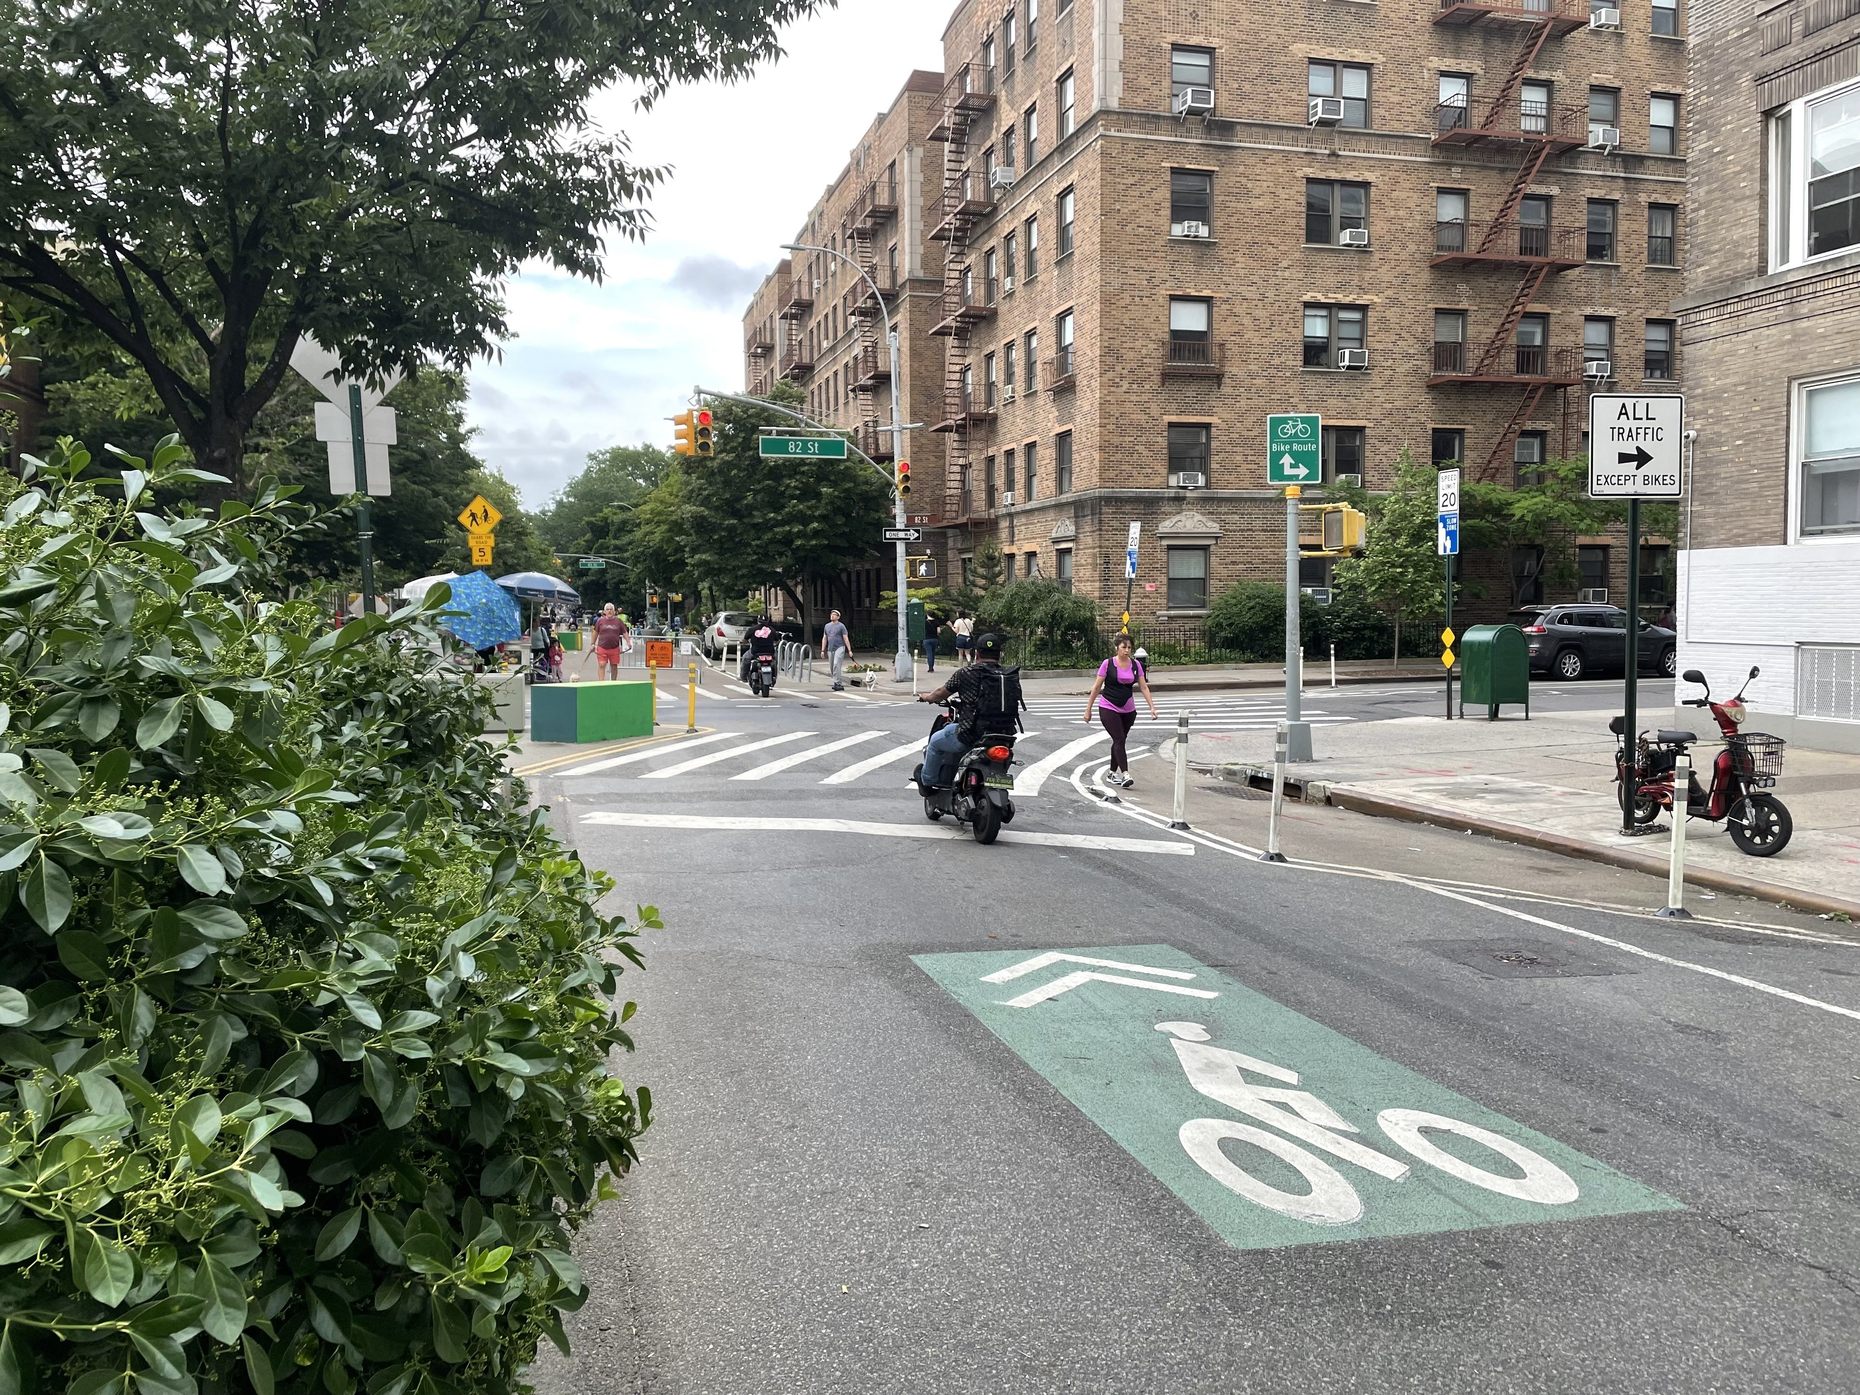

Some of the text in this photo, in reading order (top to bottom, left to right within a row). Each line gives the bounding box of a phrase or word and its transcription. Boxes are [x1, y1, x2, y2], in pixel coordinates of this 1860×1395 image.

[1617, 402, 1656, 421] ALL
[1609, 426, 1664, 442] TRAFFIC
[788, 441, 819, 454] 82 St
[1272, 443, 1317, 452] Bike Route
[1441, 474, 1457, 482] SPEED
[1596, 474, 1676, 486] EXCEPT BIKES
[1441, 492, 1456, 508] 20
[1130, 536, 1138, 546] 20
[478, 548, 486, 557] 5
